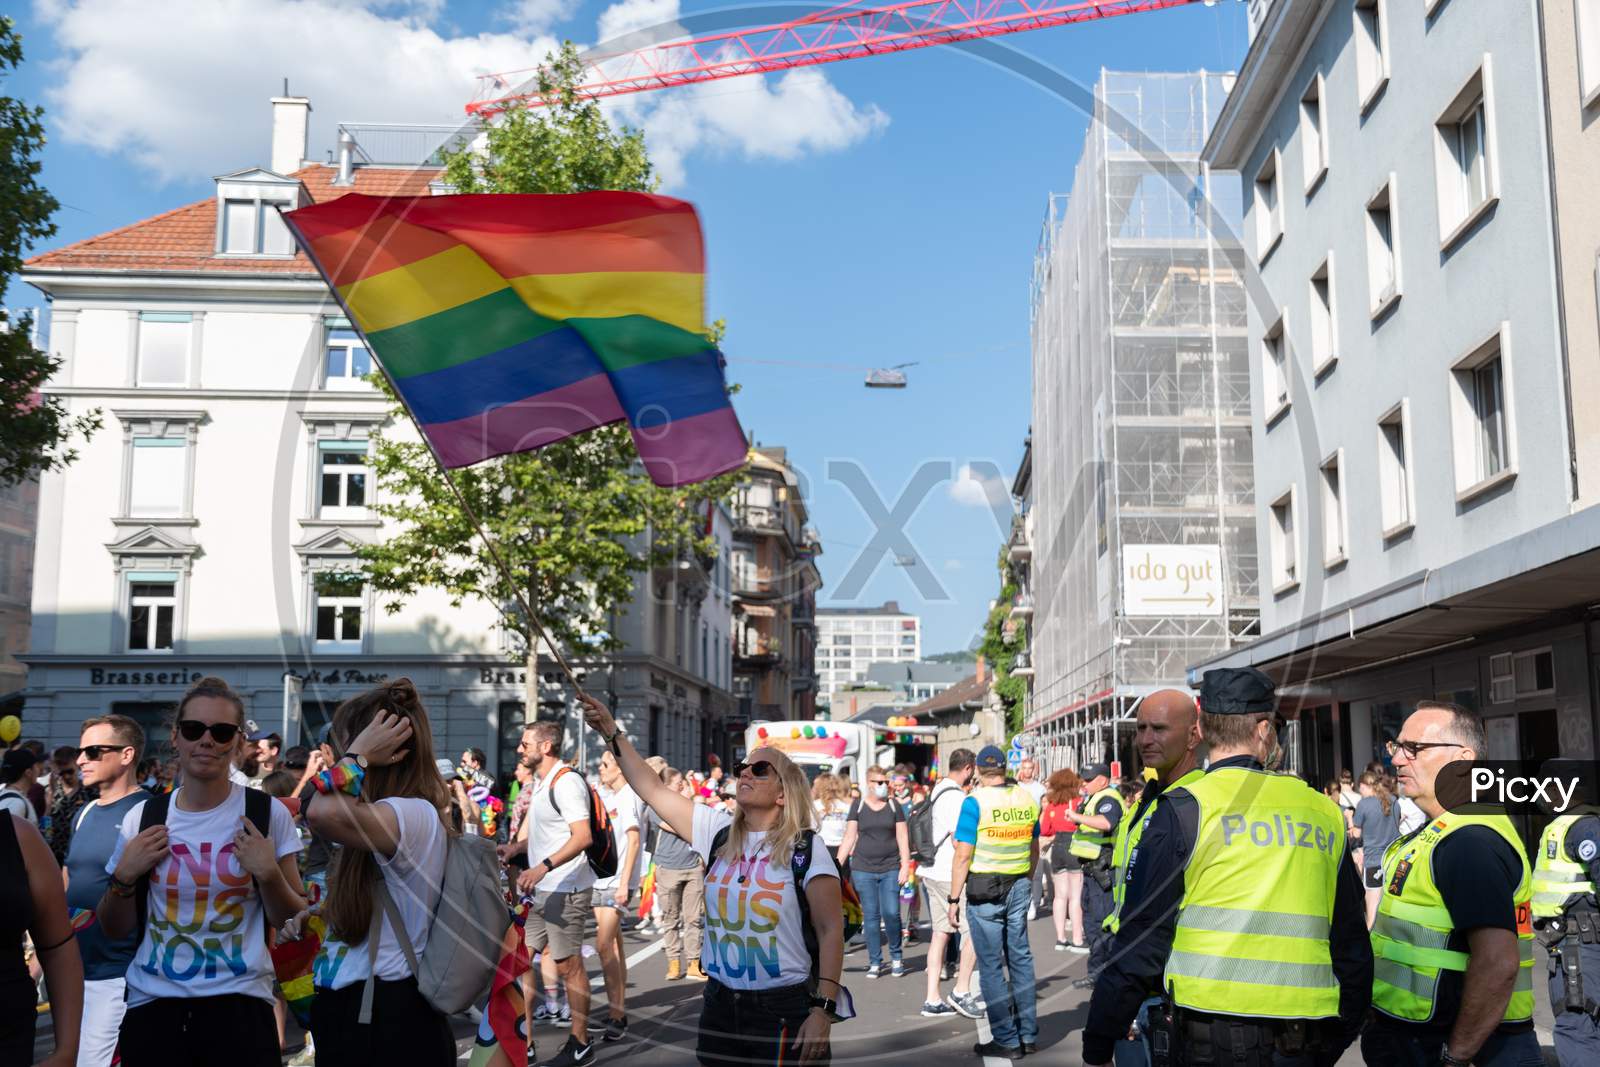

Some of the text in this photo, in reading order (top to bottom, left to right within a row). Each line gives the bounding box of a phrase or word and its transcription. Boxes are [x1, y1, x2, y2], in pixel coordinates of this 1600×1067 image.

[1130, 552, 1213, 593] ida gut
[992, 807, 1033, 823] Polizei
[708, 931, 780, 980] ION
